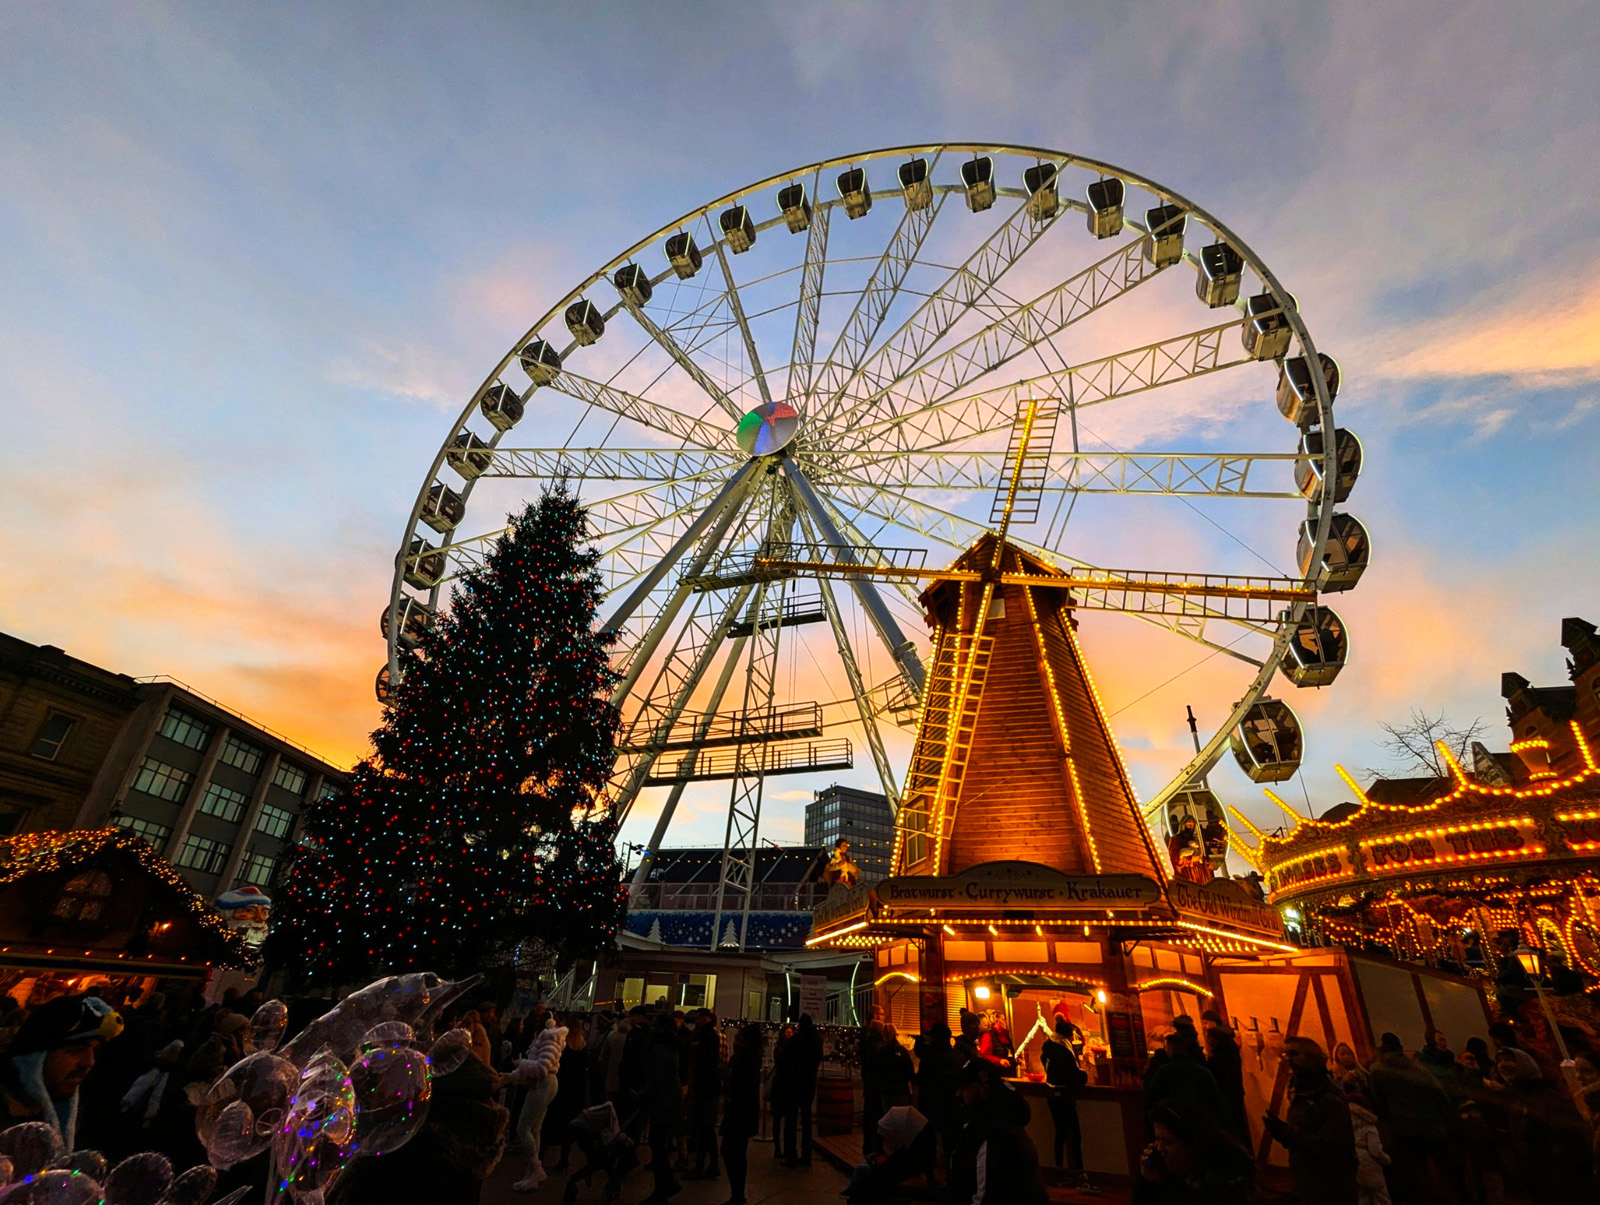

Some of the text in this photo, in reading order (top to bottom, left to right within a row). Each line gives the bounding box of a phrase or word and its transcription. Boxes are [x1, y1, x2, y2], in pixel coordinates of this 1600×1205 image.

[1371, 838, 1436, 866] FOR
[1445, 826, 1525, 855] THE
[889, 881, 1143, 903] Bratwurst Currywurst Krakauer
[1176, 882, 1198, 909] The
[1198, 889, 1218, 915] Old
